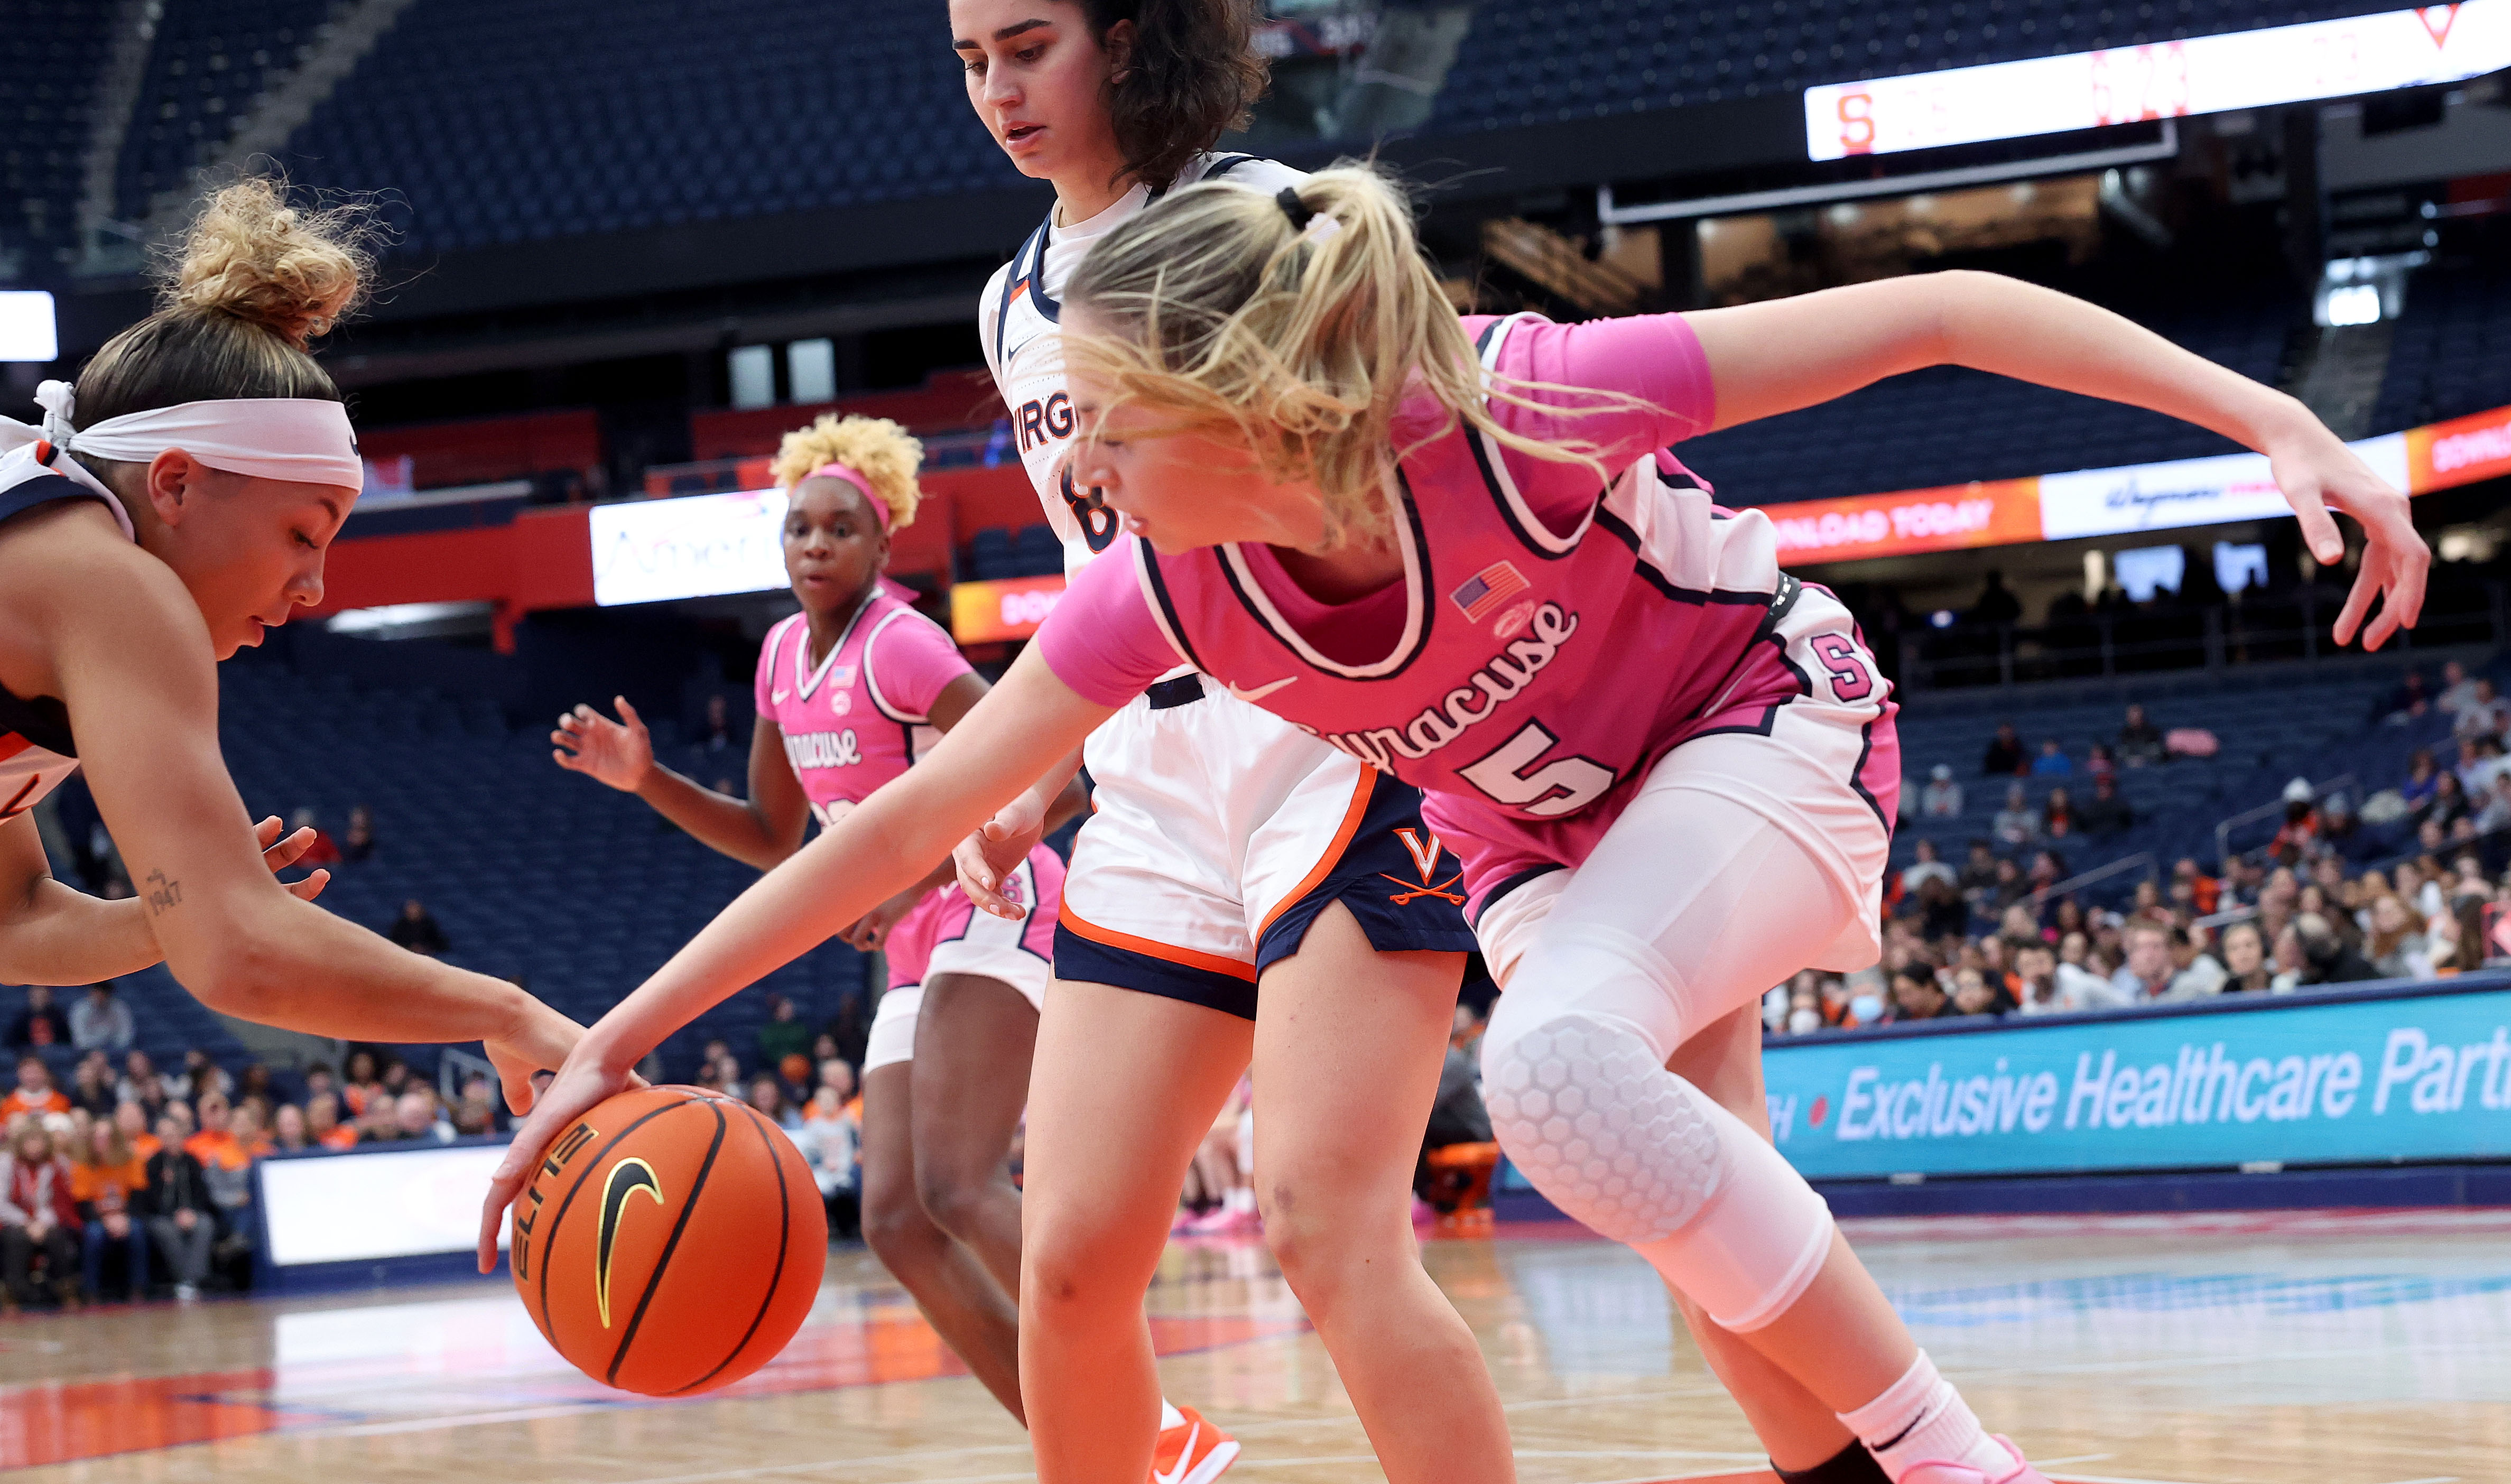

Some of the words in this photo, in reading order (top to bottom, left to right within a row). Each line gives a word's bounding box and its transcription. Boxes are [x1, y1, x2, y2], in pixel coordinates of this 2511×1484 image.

[1891, 498, 1994, 539] TODAY
[1294, 601, 1579, 776] yracuse
[1810, 633, 1873, 702] S
[1453, 716, 1618, 815] 5
[1836, 1056, 2058, 1140] Exclusive
[2063, 1041, 2362, 1129] Healthcare
